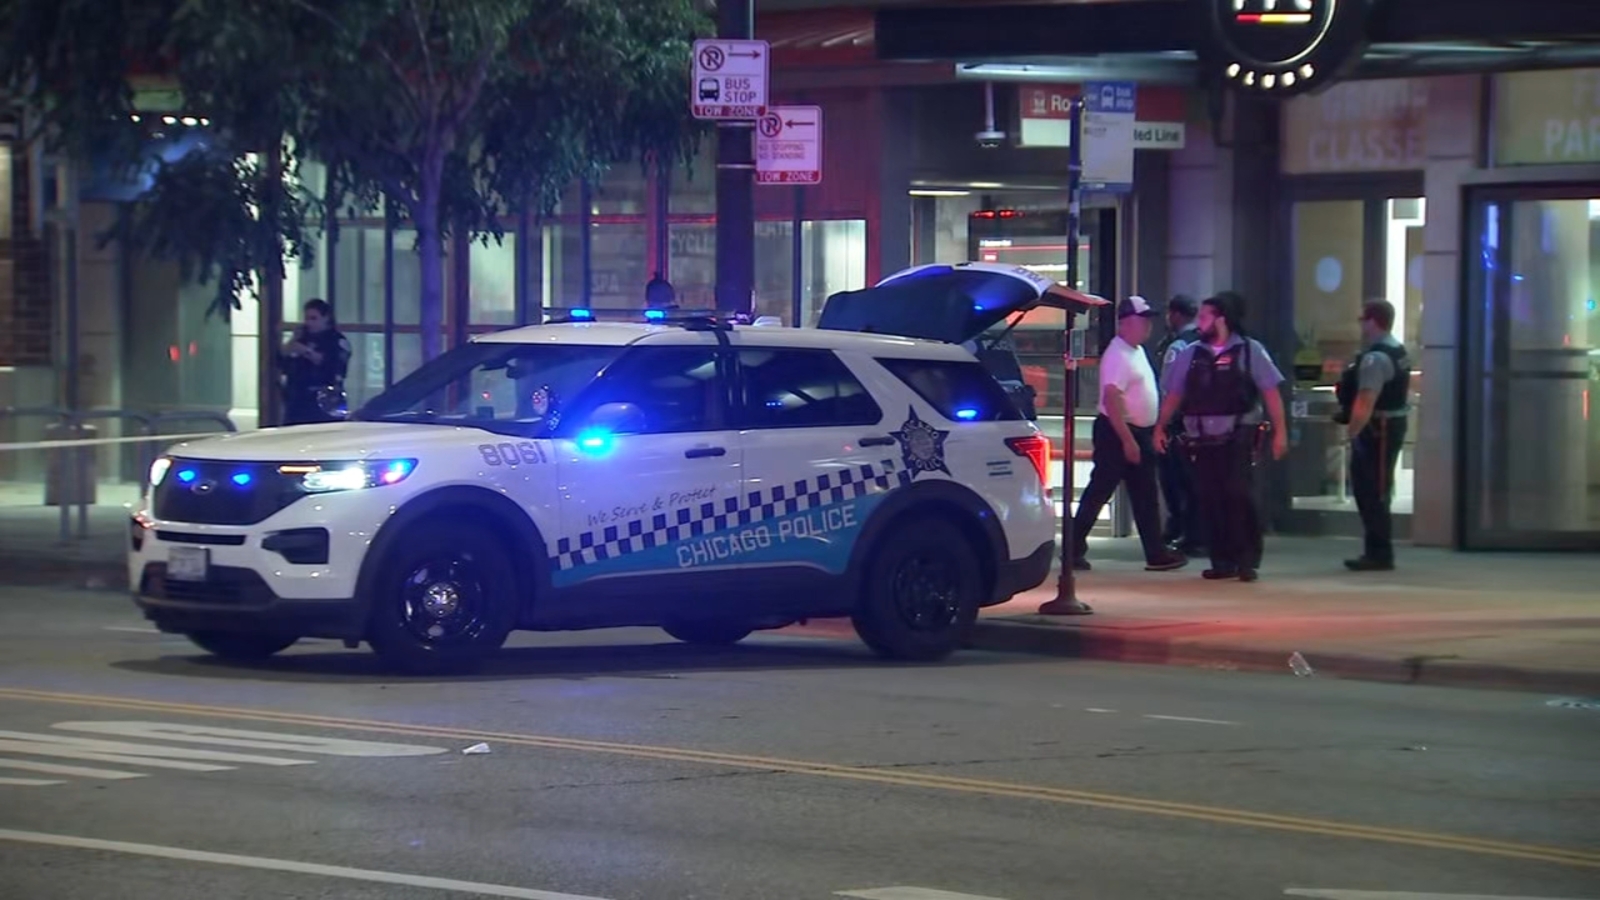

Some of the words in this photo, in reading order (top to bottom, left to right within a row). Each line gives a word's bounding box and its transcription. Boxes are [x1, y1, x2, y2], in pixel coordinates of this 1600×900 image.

[724, 78, 751, 90] BUS
[724, 91, 757, 103] STOP
[698, 106, 723, 117] TOW
[729, 106, 758, 117] ZONE
[1155, 126, 1180, 141] Line
[758, 172, 781, 182] TOW
[786, 172, 814, 182] ZONE
[478, 441, 547, 466] 8061
[587, 508, 609, 526] We
[612, 501, 647, 522] Serve
[651, 497, 664, 511] &
[669, 485, 717, 506] Protect
[676, 526, 771, 568] CHICAGO
[778, 504, 858, 543] POLICE
